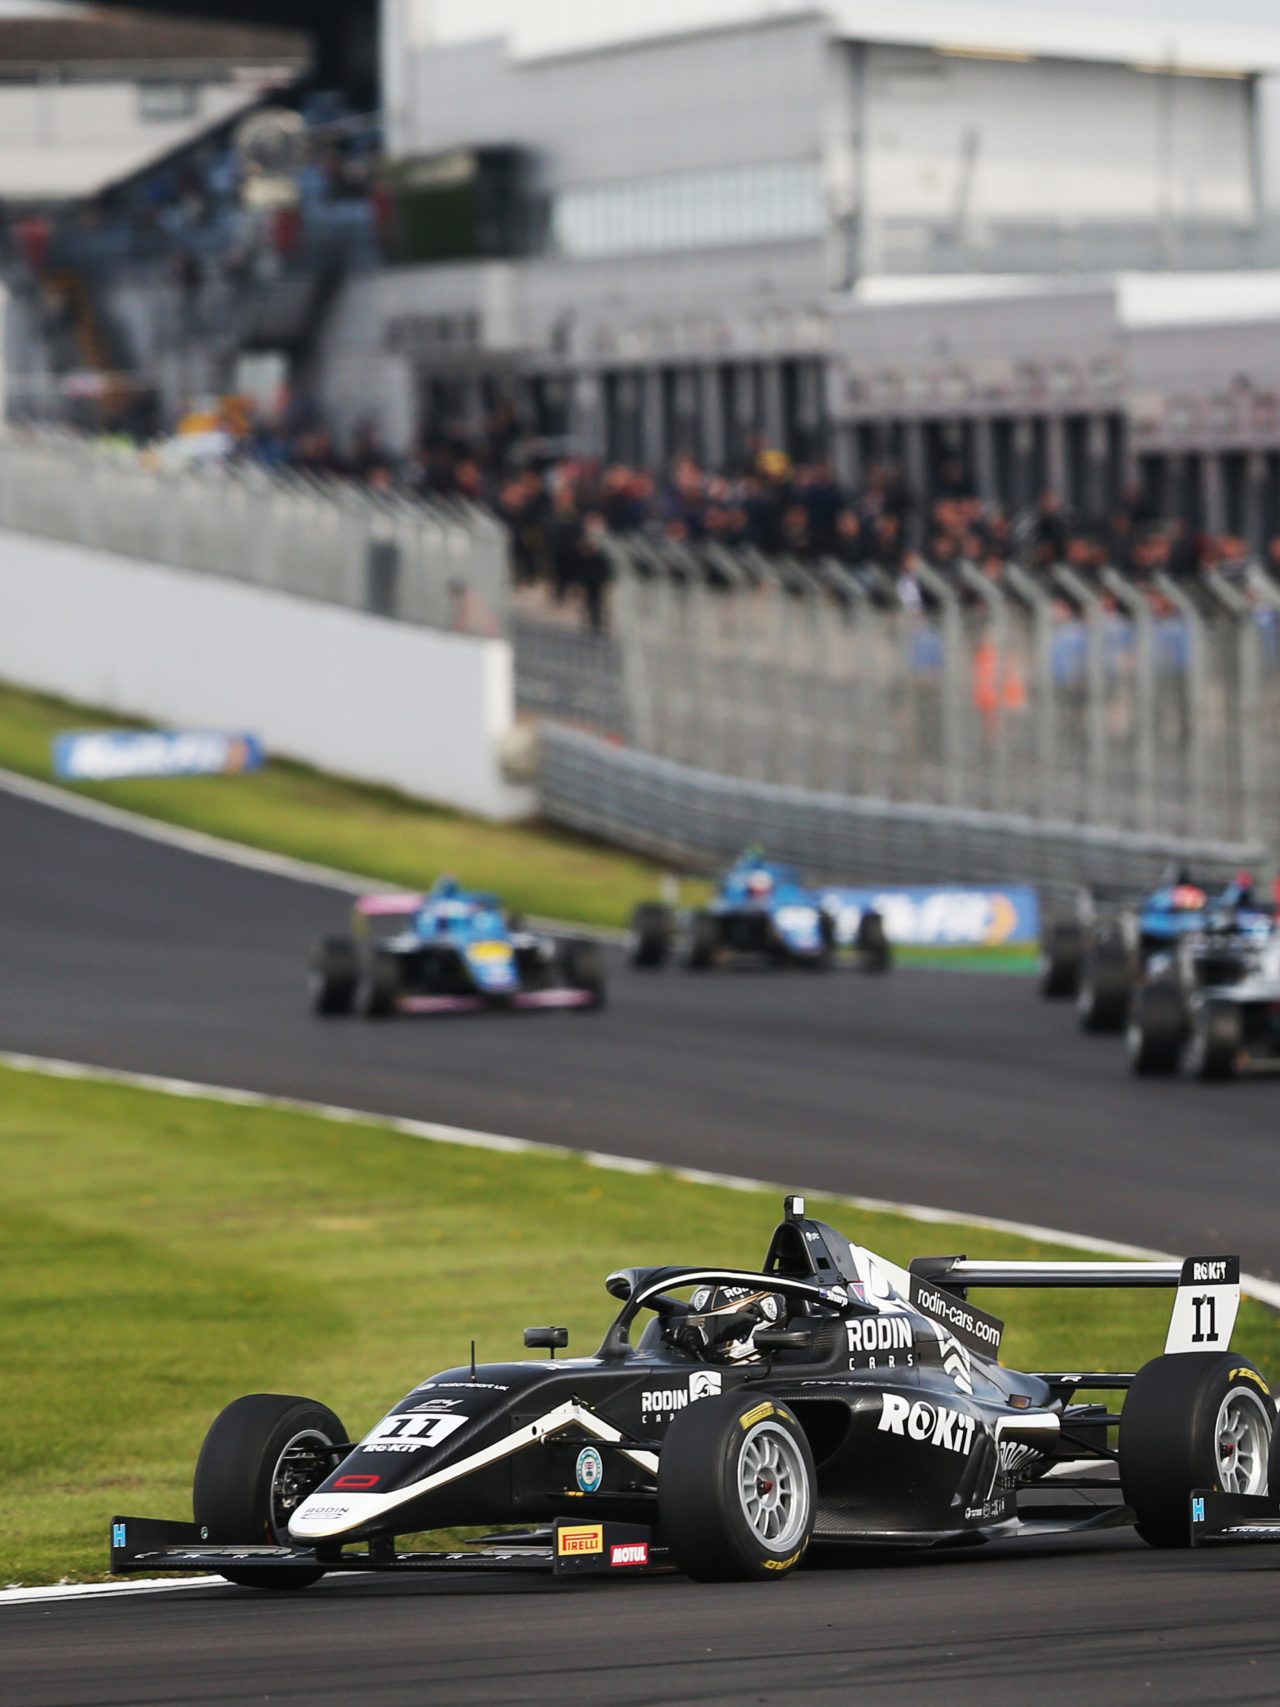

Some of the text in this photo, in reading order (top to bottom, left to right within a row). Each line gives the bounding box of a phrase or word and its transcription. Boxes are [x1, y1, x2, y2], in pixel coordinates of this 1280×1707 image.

[917, 1288, 1001, 1347] rodin-cars.com
[1191, 1296, 1219, 1342] 11
[845, 1317, 913, 1351] RODIN
[849, 1354, 913, 1370] CARS
[641, 1389, 688, 1412] RODIN
[378, 1418, 442, 1439] 11
[562, 1532, 599, 1552] PIRELLI
[611, 1546, 647, 1564] MOTUL
